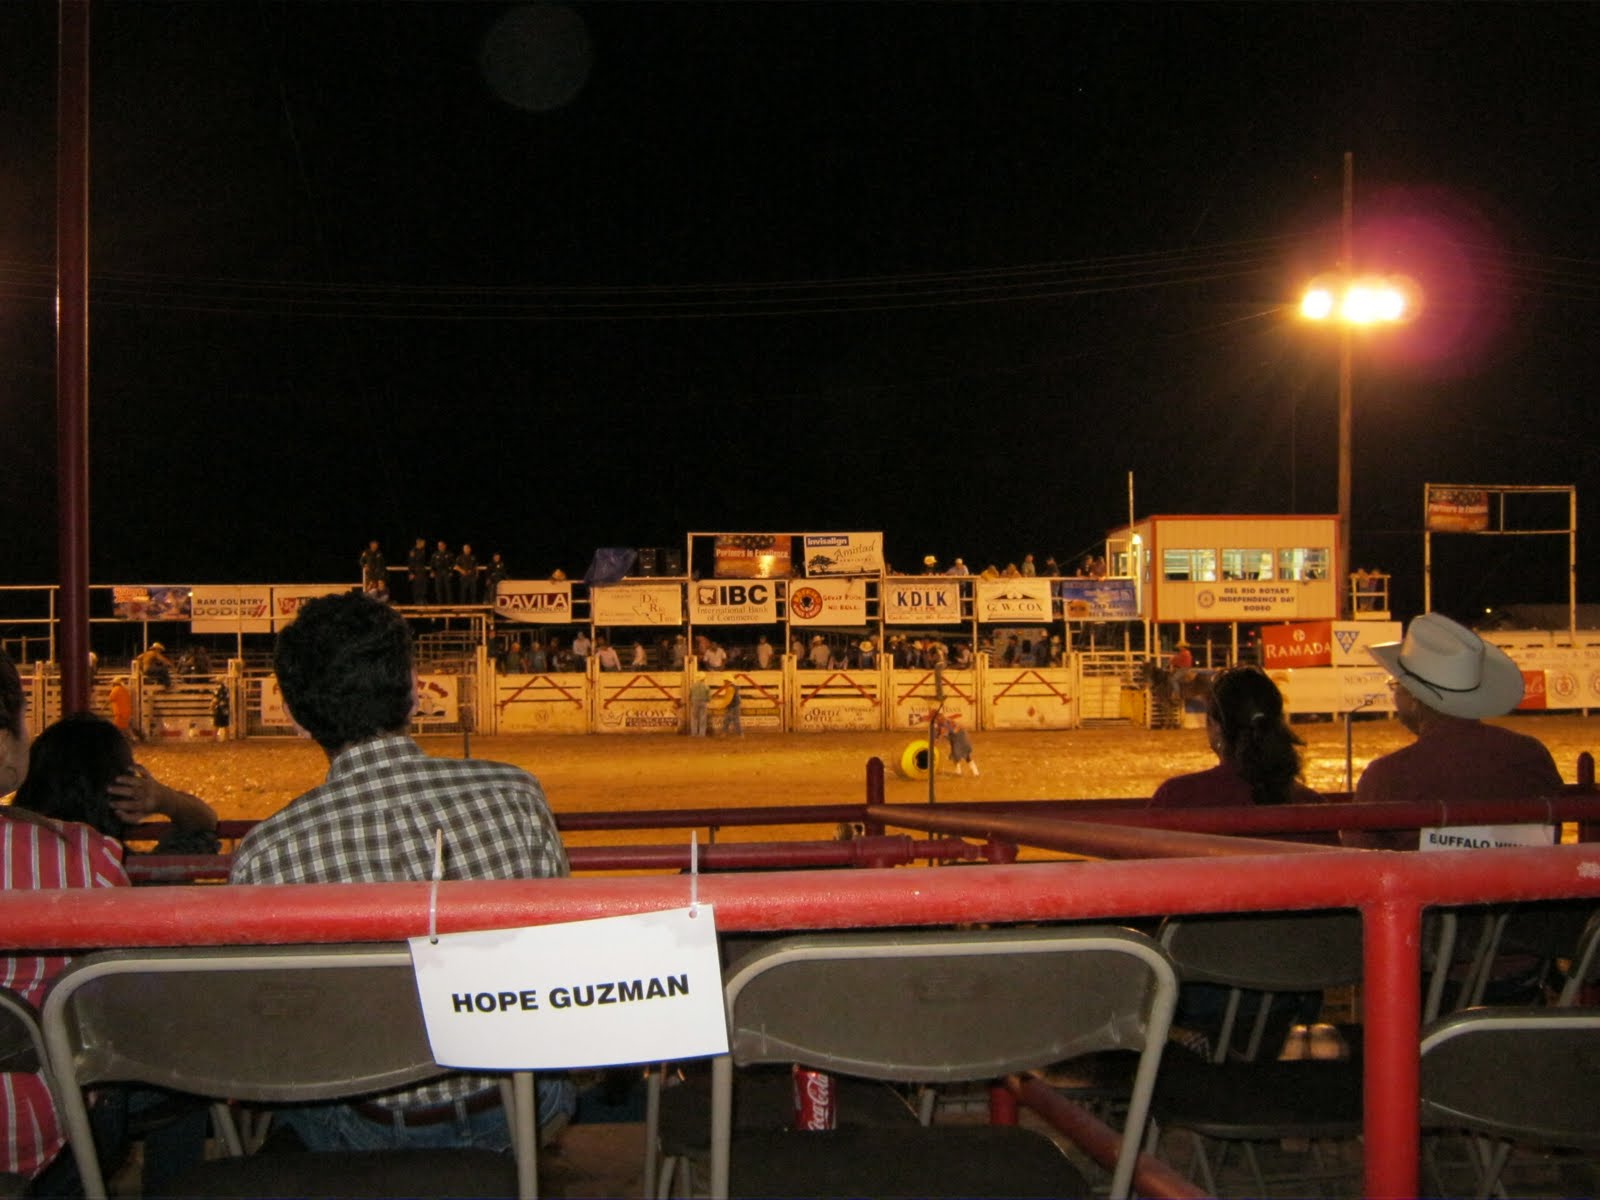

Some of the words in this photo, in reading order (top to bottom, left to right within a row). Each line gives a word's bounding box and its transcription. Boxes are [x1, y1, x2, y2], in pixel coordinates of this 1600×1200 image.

[807, 537, 847, 546] invisalign
[834, 539, 876, 560] Amistad
[496, 595, 569, 609] DAVILA
[720, 584, 768, 606] IBC
[897, 591, 947, 606] KDLK
[697, 606, 747, 614] International
[749, 606, 768, 614] Bank
[707, 614, 715, 622] of
[717, 614, 759, 622] Commerce
[1265, 642, 1331, 659] RAMADA
[1429, 833, 1491, 849] BUFFALO
[451, 989, 540, 1013] HOPE
[548, 973, 689, 1010] GUZMAN
